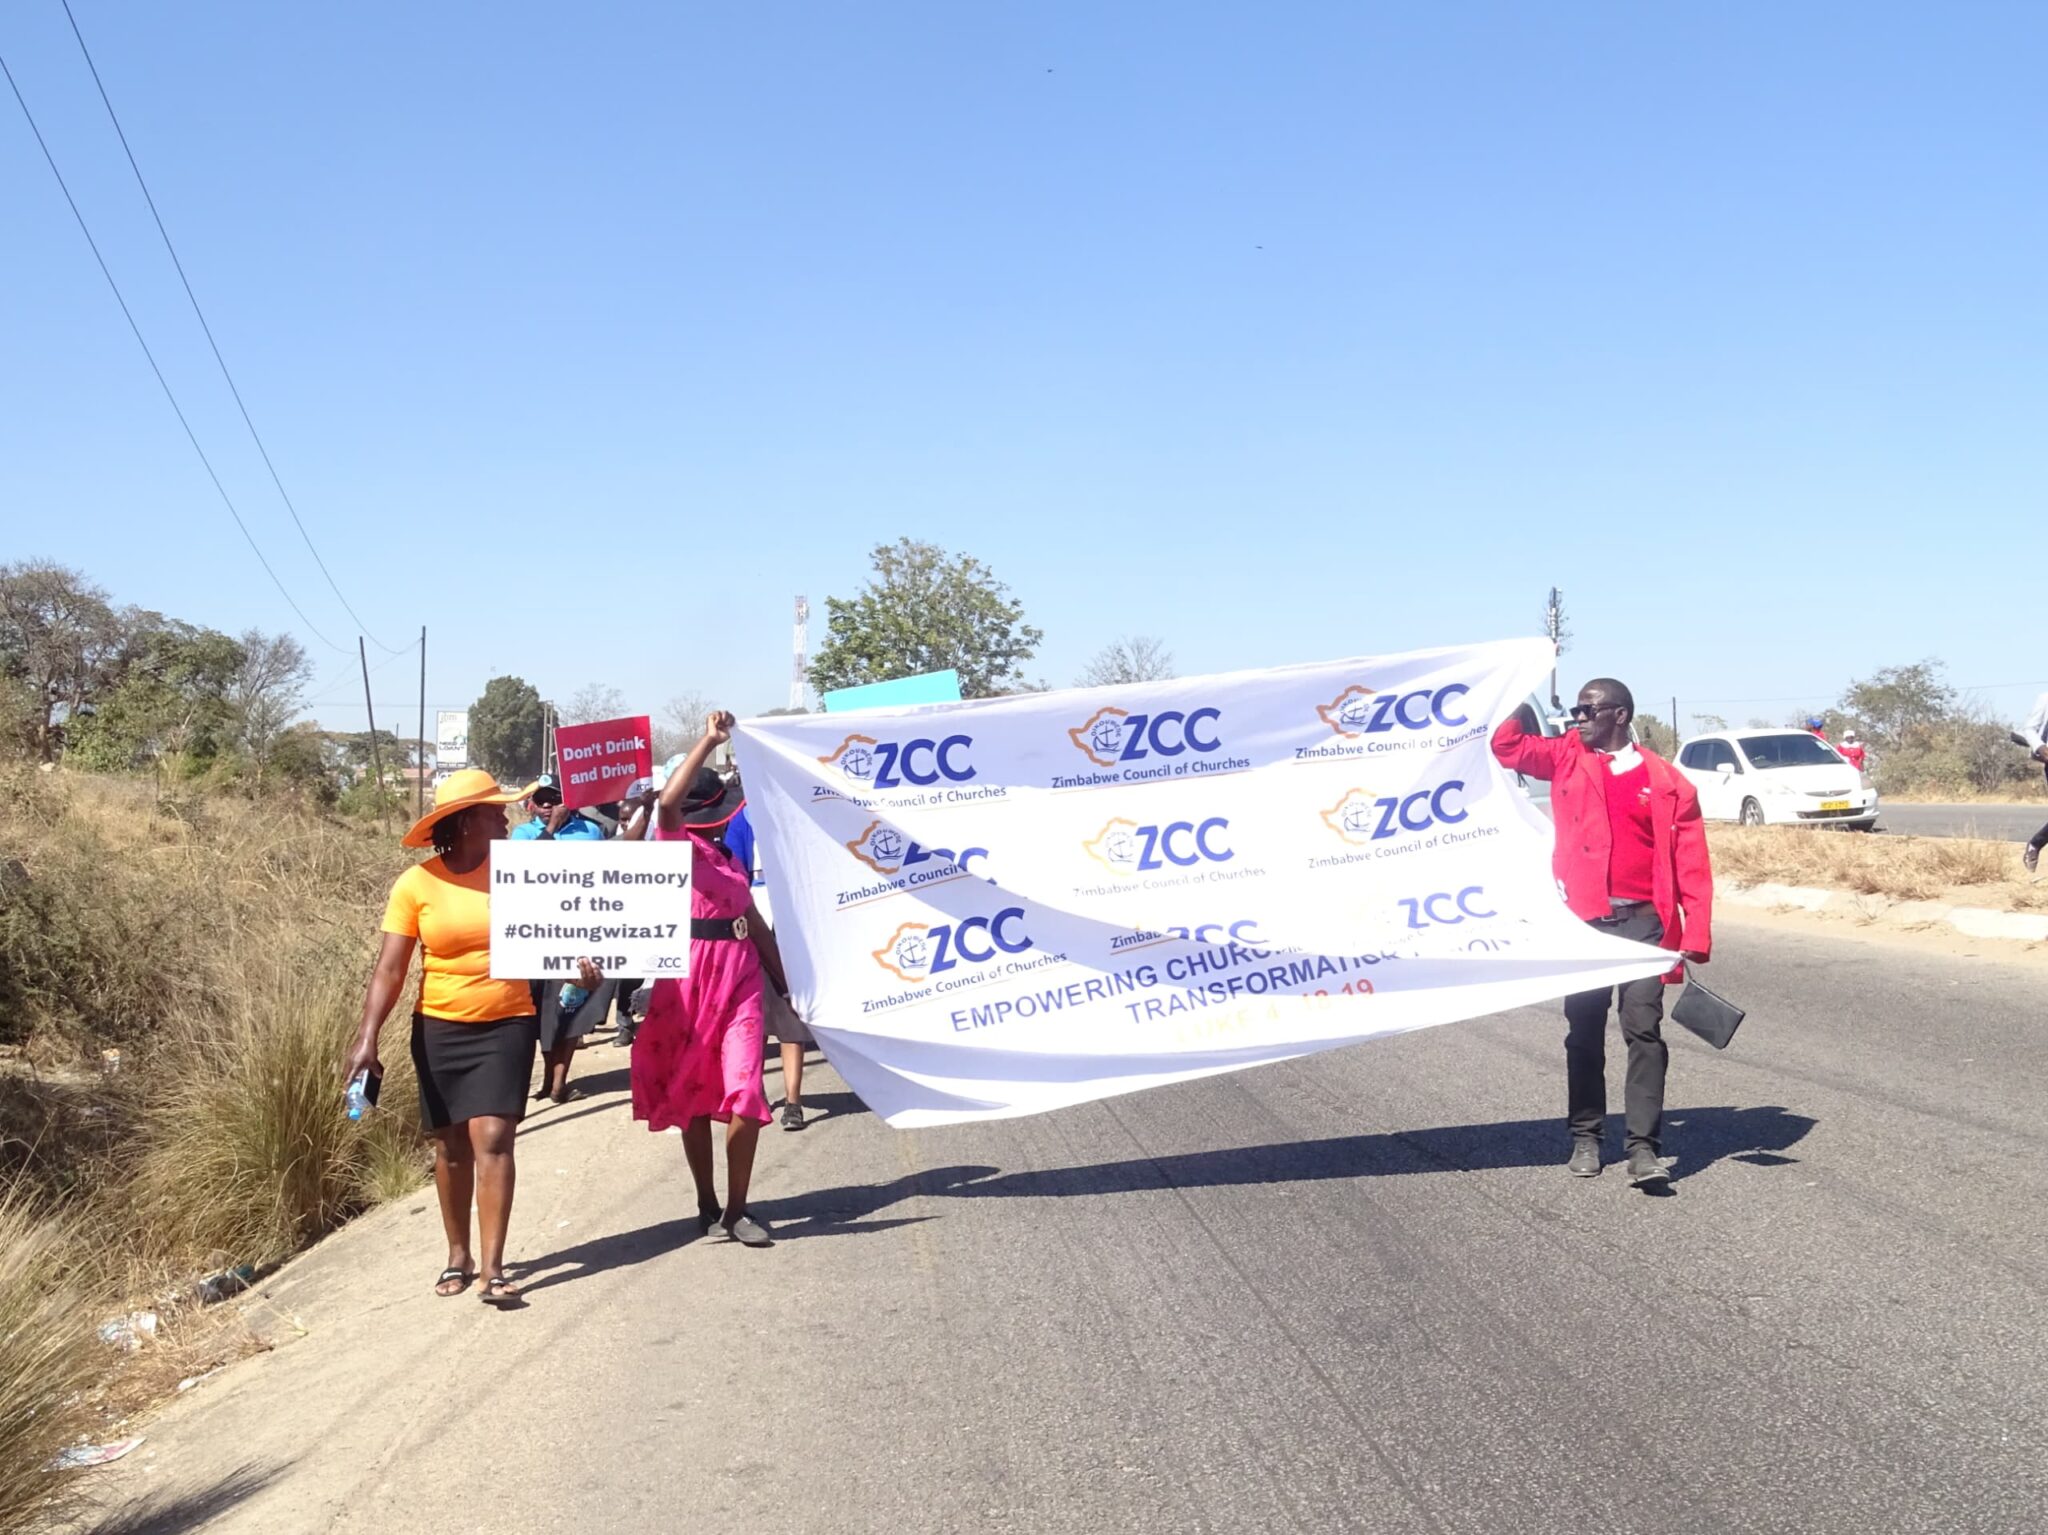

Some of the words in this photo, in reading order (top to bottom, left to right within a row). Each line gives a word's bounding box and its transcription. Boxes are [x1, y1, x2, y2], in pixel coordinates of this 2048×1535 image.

[1364, 683, 1471, 734] ZCC
[563, 742, 603, 762] Don't
[605, 735, 646, 754] Drink
[1119, 707, 1222, 761] ZCC
[1295, 743, 1364, 759] Zimbabwe
[1367, 739, 1416, 753] Council
[1419, 738, 1433, 749] of
[1437, 723, 1489, 747] Churches
[570, 766, 598, 784] and
[601, 762, 637, 779] Drive
[873, 734, 977, 789] ZCC
[1051, 770, 1120, 789] Zimbabwe
[1123, 765, 1171, 781] Council
[1175, 761, 1188, 775] of
[1191, 757, 1250, 773] Churches
[929, 792, 944, 804] of
[946, 786, 1007, 803] Churches
[1370, 780, 1469, 841] ZCC
[1135, 817, 1235, 871] ZCC
[1308, 852, 1371, 869] Zimbabwe
[1375, 840, 1422, 858] Council
[1425, 835, 1439, 849] of
[1442, 826, 1500, 845] Churches
[495, 869, 516, 884] In
[524, 869, 595, 888] Loving
[602, 870, 689, 888] Memory
[837, 878, 906, 905] Zimbabwe
[909, 864, 958, 885] Council
[1073, 880, 1139, 897] Zimbabwe
[1143, 875, 1189, 890] Council
[1193, 870, 1206, 883] of
[1209, 865, 1266, 882] Churches
[560, 896, 581, 911] of
[590, 896, 624, 911] the
[1397, 885, 1498, 929] ZCC
[504, 923, 678, 942] #Chitungwiza17
[927, 907, 1034, 974] ZCC
[657, 957, 681, 968] ZCC
[862, 986, 932, 1013] Zimbabwe
[935, 972, 985, 993] Council
[989, 966, 1002, 979] of
[1005, 953, 1068, 974] Churches
[951, 965, 1158, 1032] EMPOWERING
